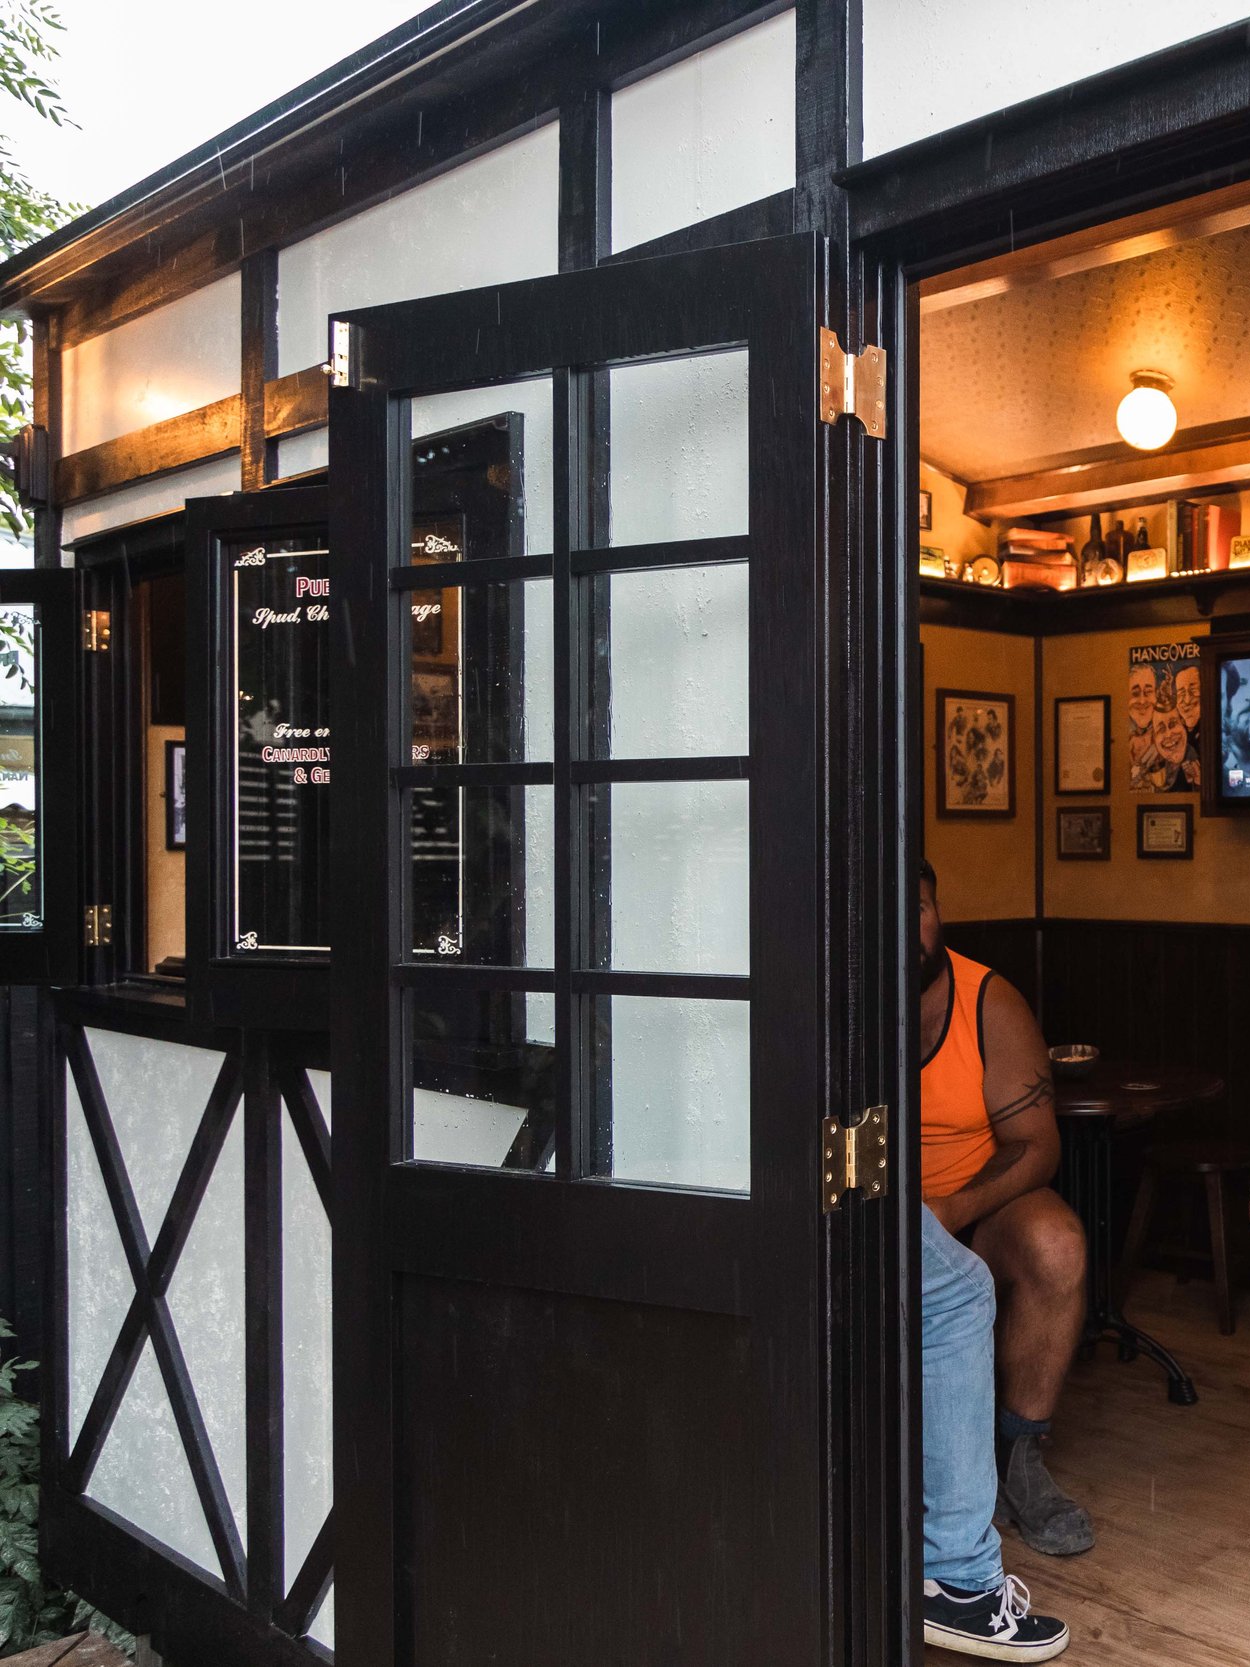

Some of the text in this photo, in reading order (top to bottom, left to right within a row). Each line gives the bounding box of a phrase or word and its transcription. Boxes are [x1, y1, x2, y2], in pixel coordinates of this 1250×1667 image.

[252, 606, 302, 629] Spud,
[411, 603, 442, 622] age
[1132, 643, 1200, 663] HANGOVER
[273, 722, 311, 738] Free
[294, 767, 308, 784] &
